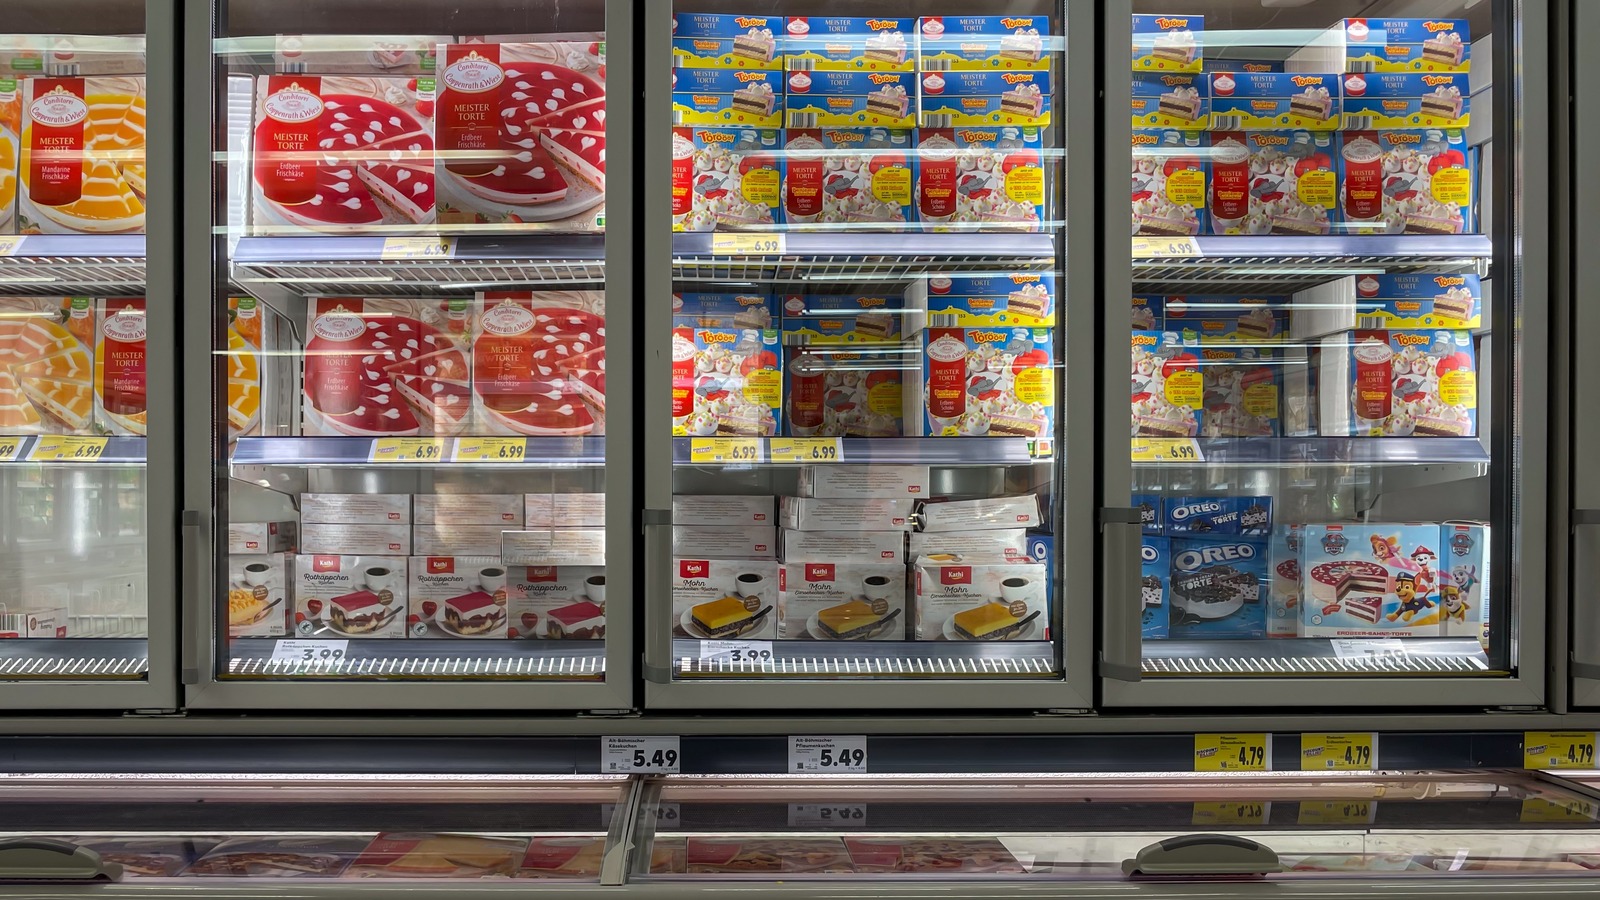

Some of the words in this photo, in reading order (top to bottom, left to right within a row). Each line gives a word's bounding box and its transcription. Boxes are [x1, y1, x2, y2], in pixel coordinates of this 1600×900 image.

[457, 63, 488, 72] Conditorei
[446, 73, 478, 89] Coppenrath
[458, 112, 486, 120] TORTE
[40, 137, 75, 145] MEISTER
[274, 133, 308, 142] MEISTER
[277, 142, 304, 150] TORTE
[458, 140, 486, 148] Frischkäse
[424, 244, 448, 255] 6.99
[755, 241, 778, 252] 6.99
[1169, 244, 1192, 254] 6.99
[325, 358, 349, 366] TORTE
[74, 445, 101, 458] 6.99
[416, 446, 440, 458] 6.99
[498, 446, 524, 458] 6.99
[733, 446, 756, 458] 6.99
[812, 446, 836, 458] 6.99
[1171, 446, 1194, 458] 6.99
[1172, 502, 1220, 520] OREO
[1213, 516, 1238, 524] TORTE
[1175, 544, 1254, 570] OREO
[517, 584, 568, 592] Rotkäppchen
[1180, 578, 1212, 590] TORTE
[302, 649, 344, 660] 3.99
[730, 650, 770, 661] 3.99
[633, 750, 678, 767] 5.49
[820, 749, 864, 766] 5.49
[1239, 746, 1264, 766] 4.79
[1345, 746, 1370, 764] 4.79
[1568, 744, 1593, 762] 4.79
